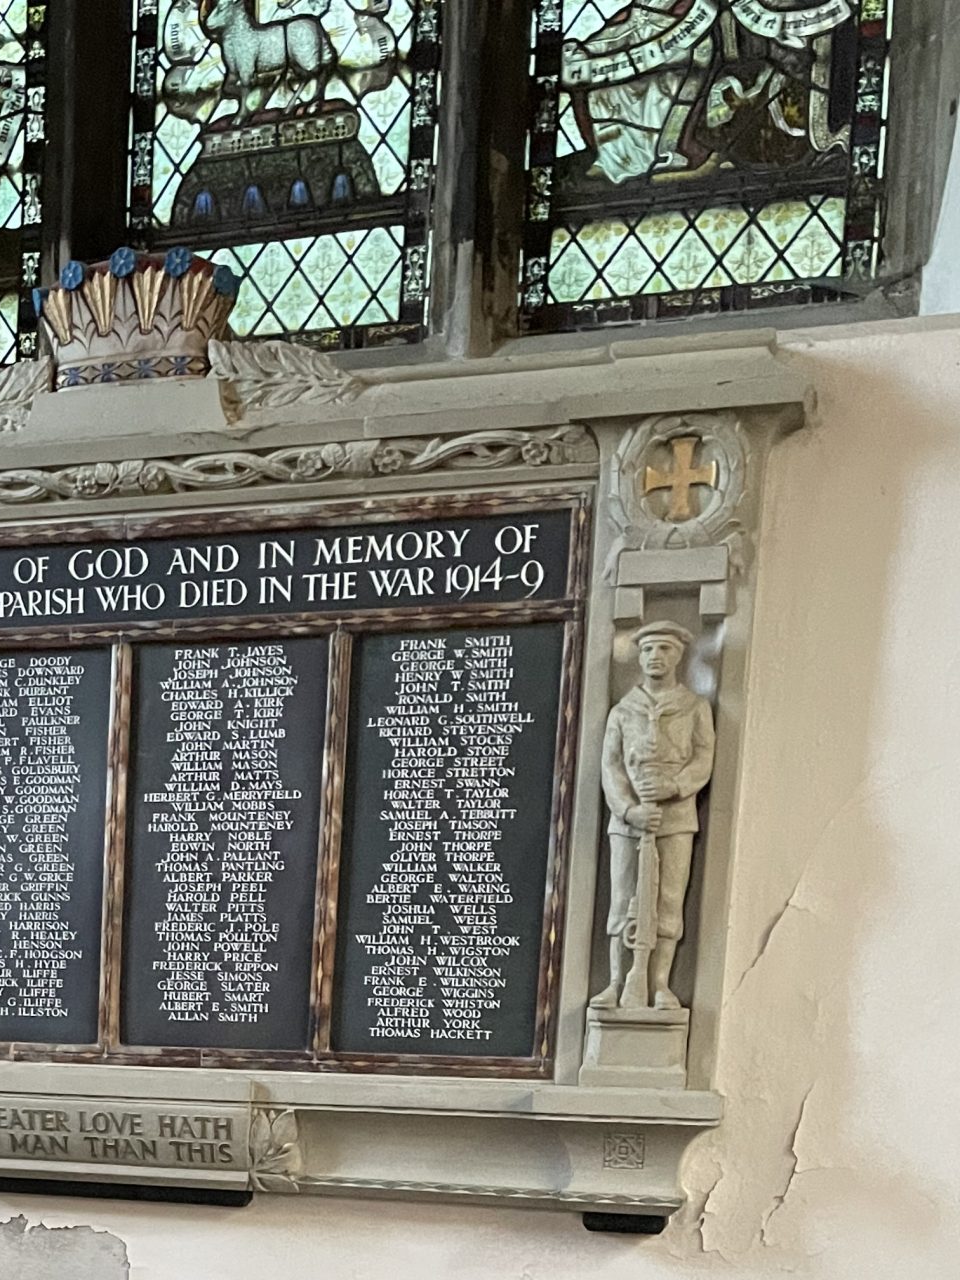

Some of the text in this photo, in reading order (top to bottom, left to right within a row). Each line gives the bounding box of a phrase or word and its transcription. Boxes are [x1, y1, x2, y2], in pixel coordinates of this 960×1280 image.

[13, 556, 49, 583] OF
[68, 547, 149, 580] GOD
[166, 544, 239, 575] AND
[258, 540, 296, 569] IN
[313, 529, 471, 566] MEMORY
[495, 524, 539, 554] OF
[95, 583, 165, 612] WHO
[179, 578, 247, 608] DIED
[259, 575, 293, 604] IN
[302, 572, 357, 601] THE
[368, 566, 435, 597] WAR
[445, 556, 545, 599] 1914-9
[400, 635, 511, 650] FRANK SMITH
[30, 656, 72, 667] DOODY
[18, 666, 84, 677] DOWNWARD
[18, 686, 69, 696] DURRANT
[28, 696, 73, 706] ELLIOT
[398, 692, 506, 705] RONALD SMITH
[31, 706, 70, 716] EVANS
[22, 716, 80, 726] FAULKNER
[175, 719, 278, 732] JOHN KNIGHT
[379, 724, 523, 737] RICHARD STEVENSON
[30, 736, 71, 745] FISHER
[177, 739, 275, 752] JOHN MARTIN
[389, 735, 512, 747] WILLIAM STOCKS
[12, 765, 80, 775] GOLDSBURY
[169, 770, 279, 782] ARTHUR MATTS
[394, 778, 500, 789] ERNEST SWANN
[15, 785, 74, 795] GOODMAN
[171, 801, 275, 812] WILLIAM MOBBS
[25, 814, 67, 823] GREEN
[148, 821, 294, 832] HAROLD MOUNTENEY
[389, 820, 497, 831] JOSEPH TIMSON
[169, 831, 272, 842] HARRY NOBLE
[390, 851, 495, 862] OLIVER THORPE
[155, 861, 284, 873] THOMAS PANTLING
[382, 862, 501, 872] WILLIAM WALKER
[163, 872, 273, 882] ALBERT PARKER
[21, 883, 68, 891] GRIFFIN
[169, 883, 267, 893] JOSEPH PEEL
[31, 892, 70, 901] GUNNS
[366, 894, 513, 904] BERTIE WATERFIELD
[382, 904, 496, 916] JOSHUA WELLS
[9, 921, 69, 930] HARRISON
[157, 932, 278, 942] THOMAS POULTON
[167, 952, 262, 962] HARRY PRICE
[385, 955, 488, 966] JOHN WILCOX
[153, 961, 278, 972] FREDERICK RIPPON
[371, 966, 502, 977] ERNEST WILKINSON
[23, 969, 57, 978] ILIFFE
[27, 979, 63, 988] ILIFFE
[157, 981, 270, 992] GEORGE SLATER
[164, 991, 264, 1002] HUBERT SMART
[373, 986, 494, 998] GEORGE WIGGINS
[168, 1012, 258, 1022] ALLAN SMITH
[376, 1018, 480, 1029] ARTHUR YORK
[369, 1028, 492, 1040] THOMAS HACKETT
[79, 1111, 142, 1135] LOVE
[158, 1115, 233, 1141] HATH
[8, 1132, 68, 1154] MAN
[83, 1137, 157, 1160] THAN
[169, 1141, 233, 1163] THIS
